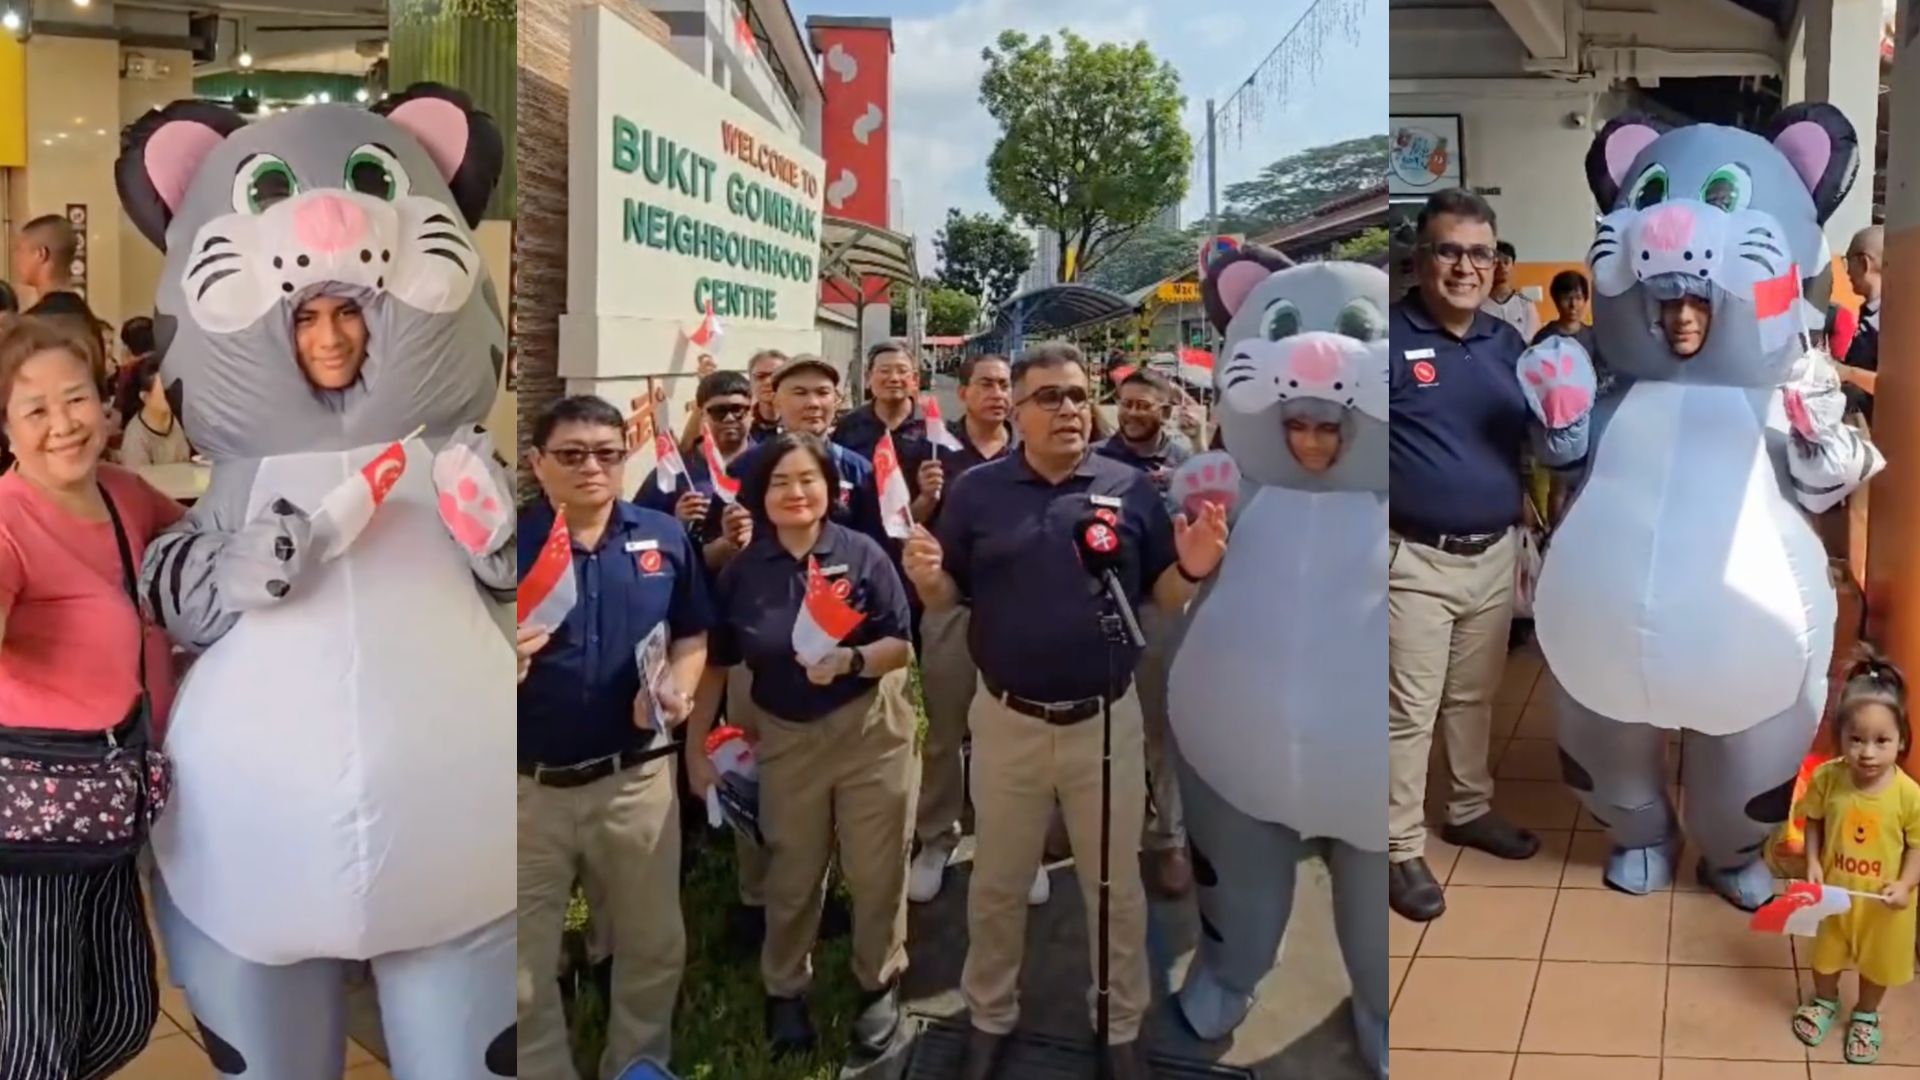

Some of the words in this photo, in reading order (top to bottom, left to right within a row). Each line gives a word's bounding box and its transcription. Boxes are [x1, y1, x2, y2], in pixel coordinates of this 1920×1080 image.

[612, 115, 717, 203] BUKIT
[727, 171, 816, 243] GOMBAK
[721, 120, 799, 189] WELCOME
[801, 170, 818, 199] TO
[622, 198, 813, 283] NEIGHBOURHOOD
[694, 276, 777, 321] CENTRE
